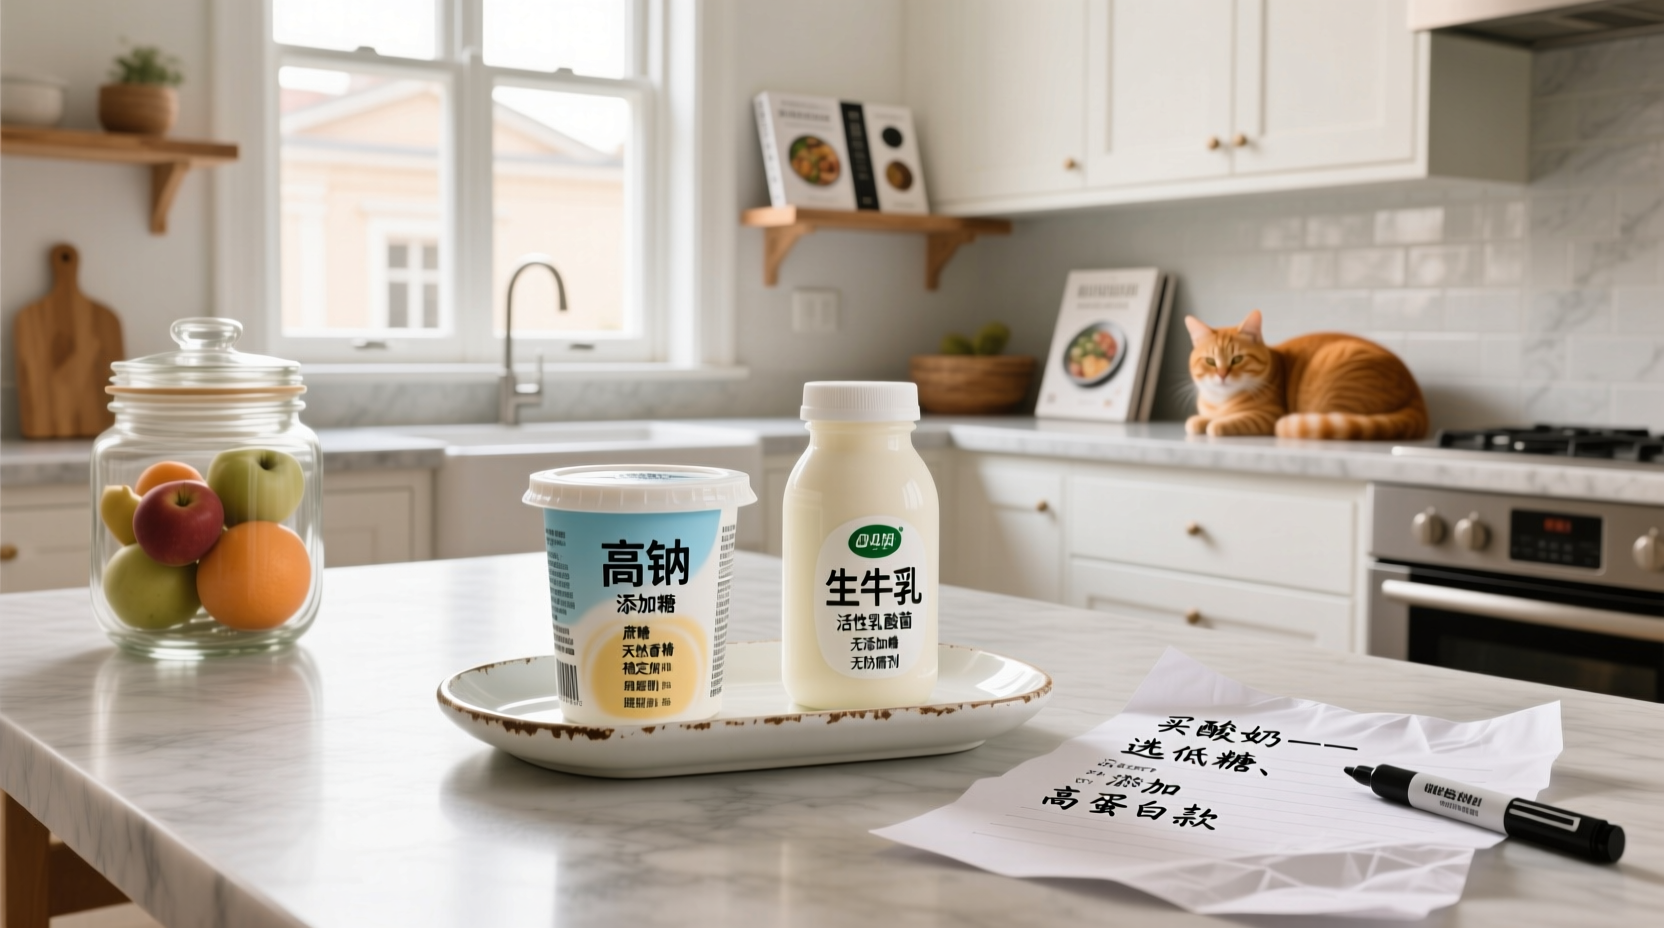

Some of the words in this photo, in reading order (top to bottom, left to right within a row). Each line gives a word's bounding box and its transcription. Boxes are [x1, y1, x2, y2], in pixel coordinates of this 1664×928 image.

[601, 538, 690, 588] 高钠
[616, 593, 676, 615] 添加糖
[825, 566, 922, 607] 生牛乳
[836, 611, 912, 631] 活性乳酸菌
[1042, 785, 1218, 831] 高蛋白款
